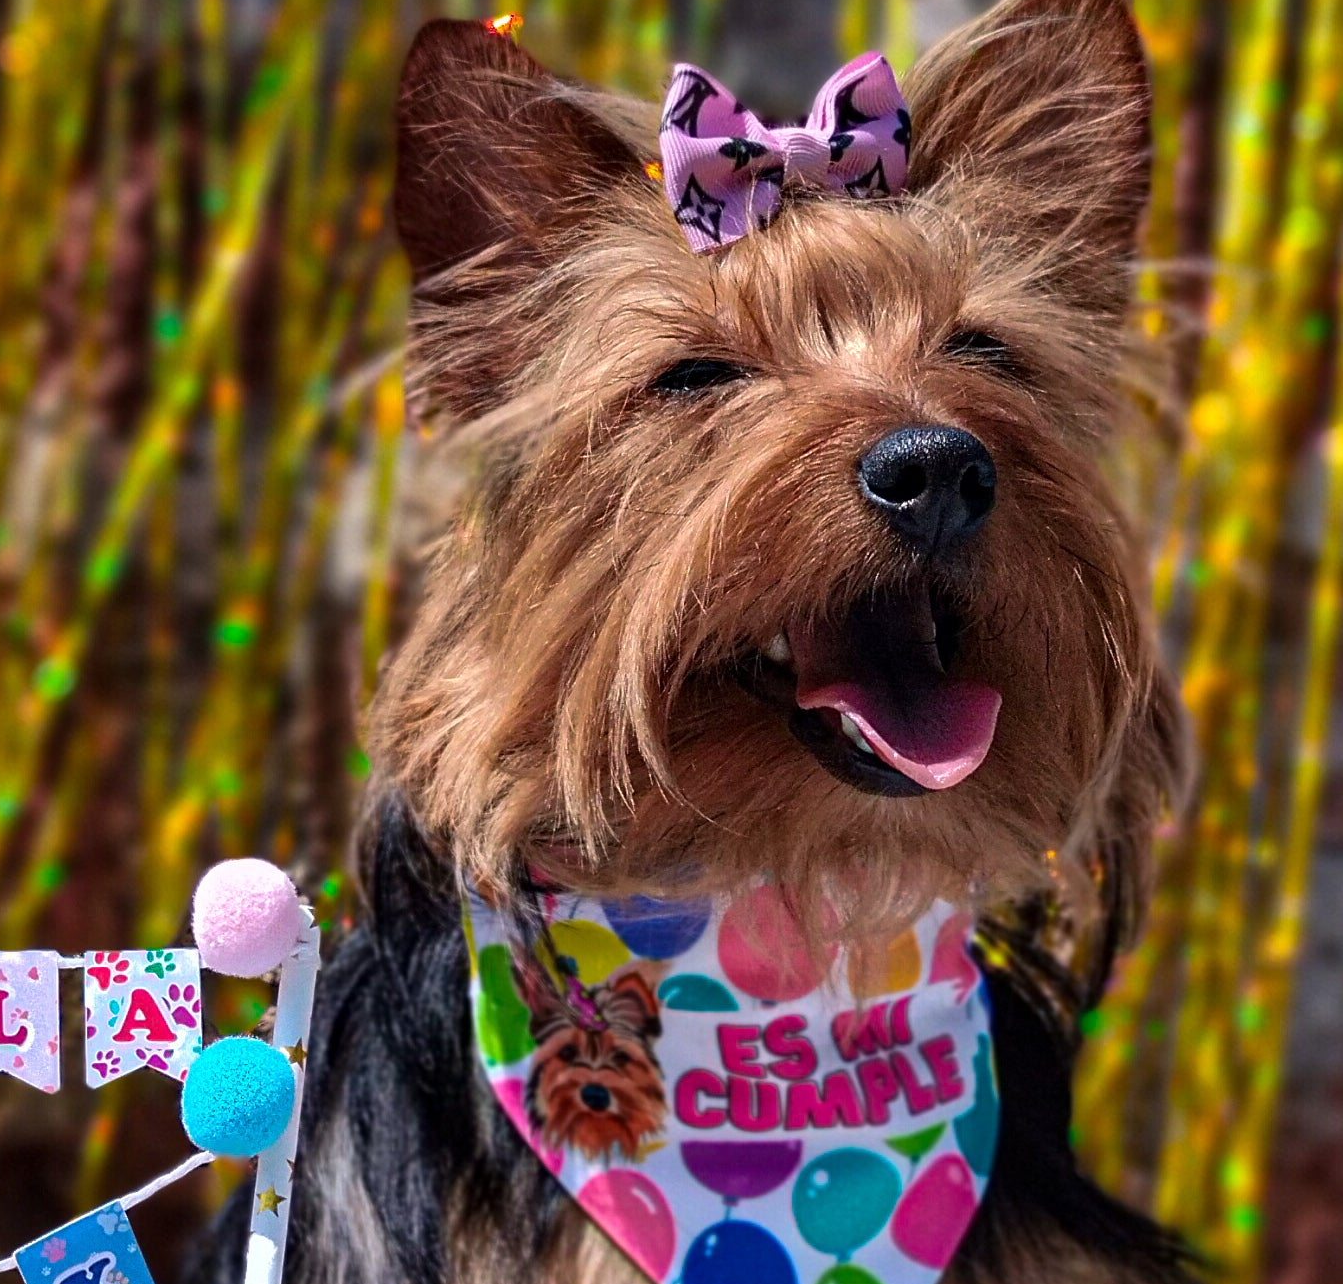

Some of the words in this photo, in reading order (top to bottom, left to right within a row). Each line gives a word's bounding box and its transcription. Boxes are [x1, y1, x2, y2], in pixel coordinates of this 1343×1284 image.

[717, 1014, 818, 1079] ES
[831, 994, 915, 1062] MI
[674, 1033, 965, 1133] CUMPLE
